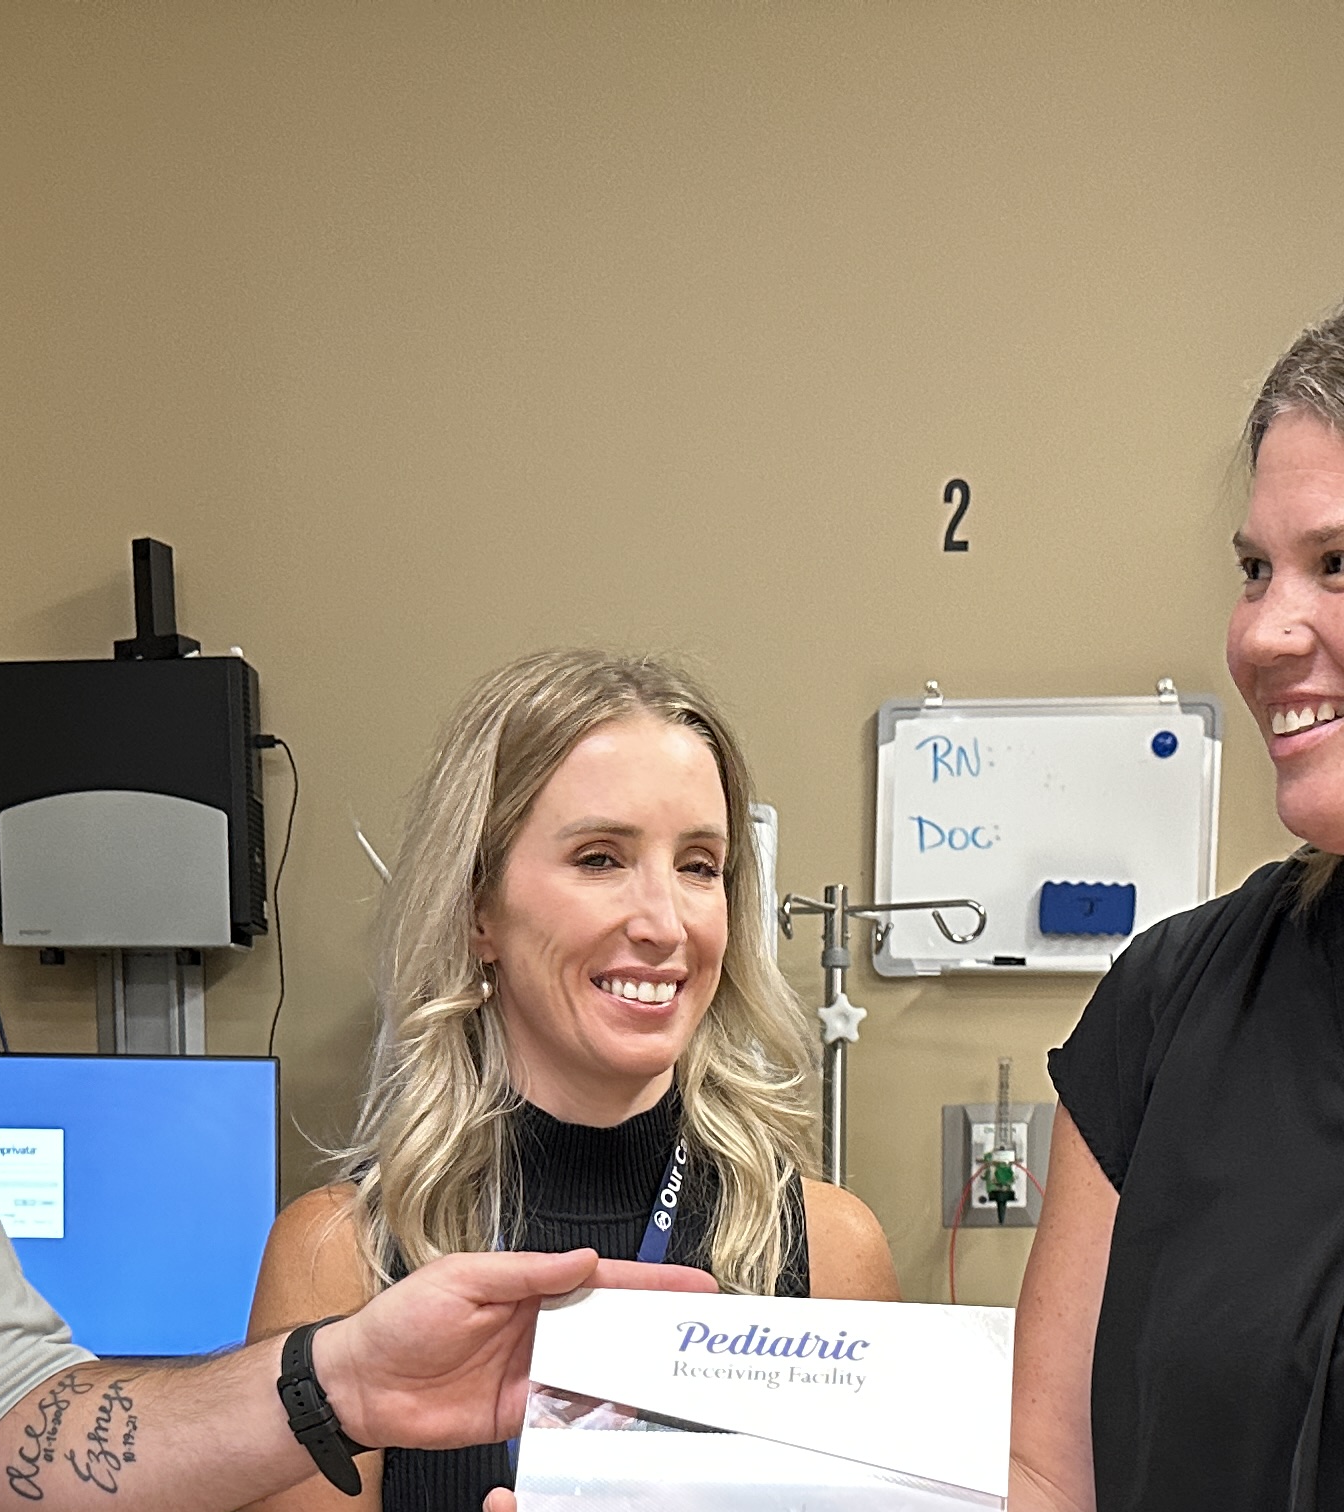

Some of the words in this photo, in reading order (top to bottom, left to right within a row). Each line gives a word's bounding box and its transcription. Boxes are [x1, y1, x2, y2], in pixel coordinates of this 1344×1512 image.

[943, 479, 970, 552] 2
[676, 1320, 871, 1361] Pediatric
[672, 1360, 781, 1390] Receiving
[788, 1366, 868, 1393] Facility
